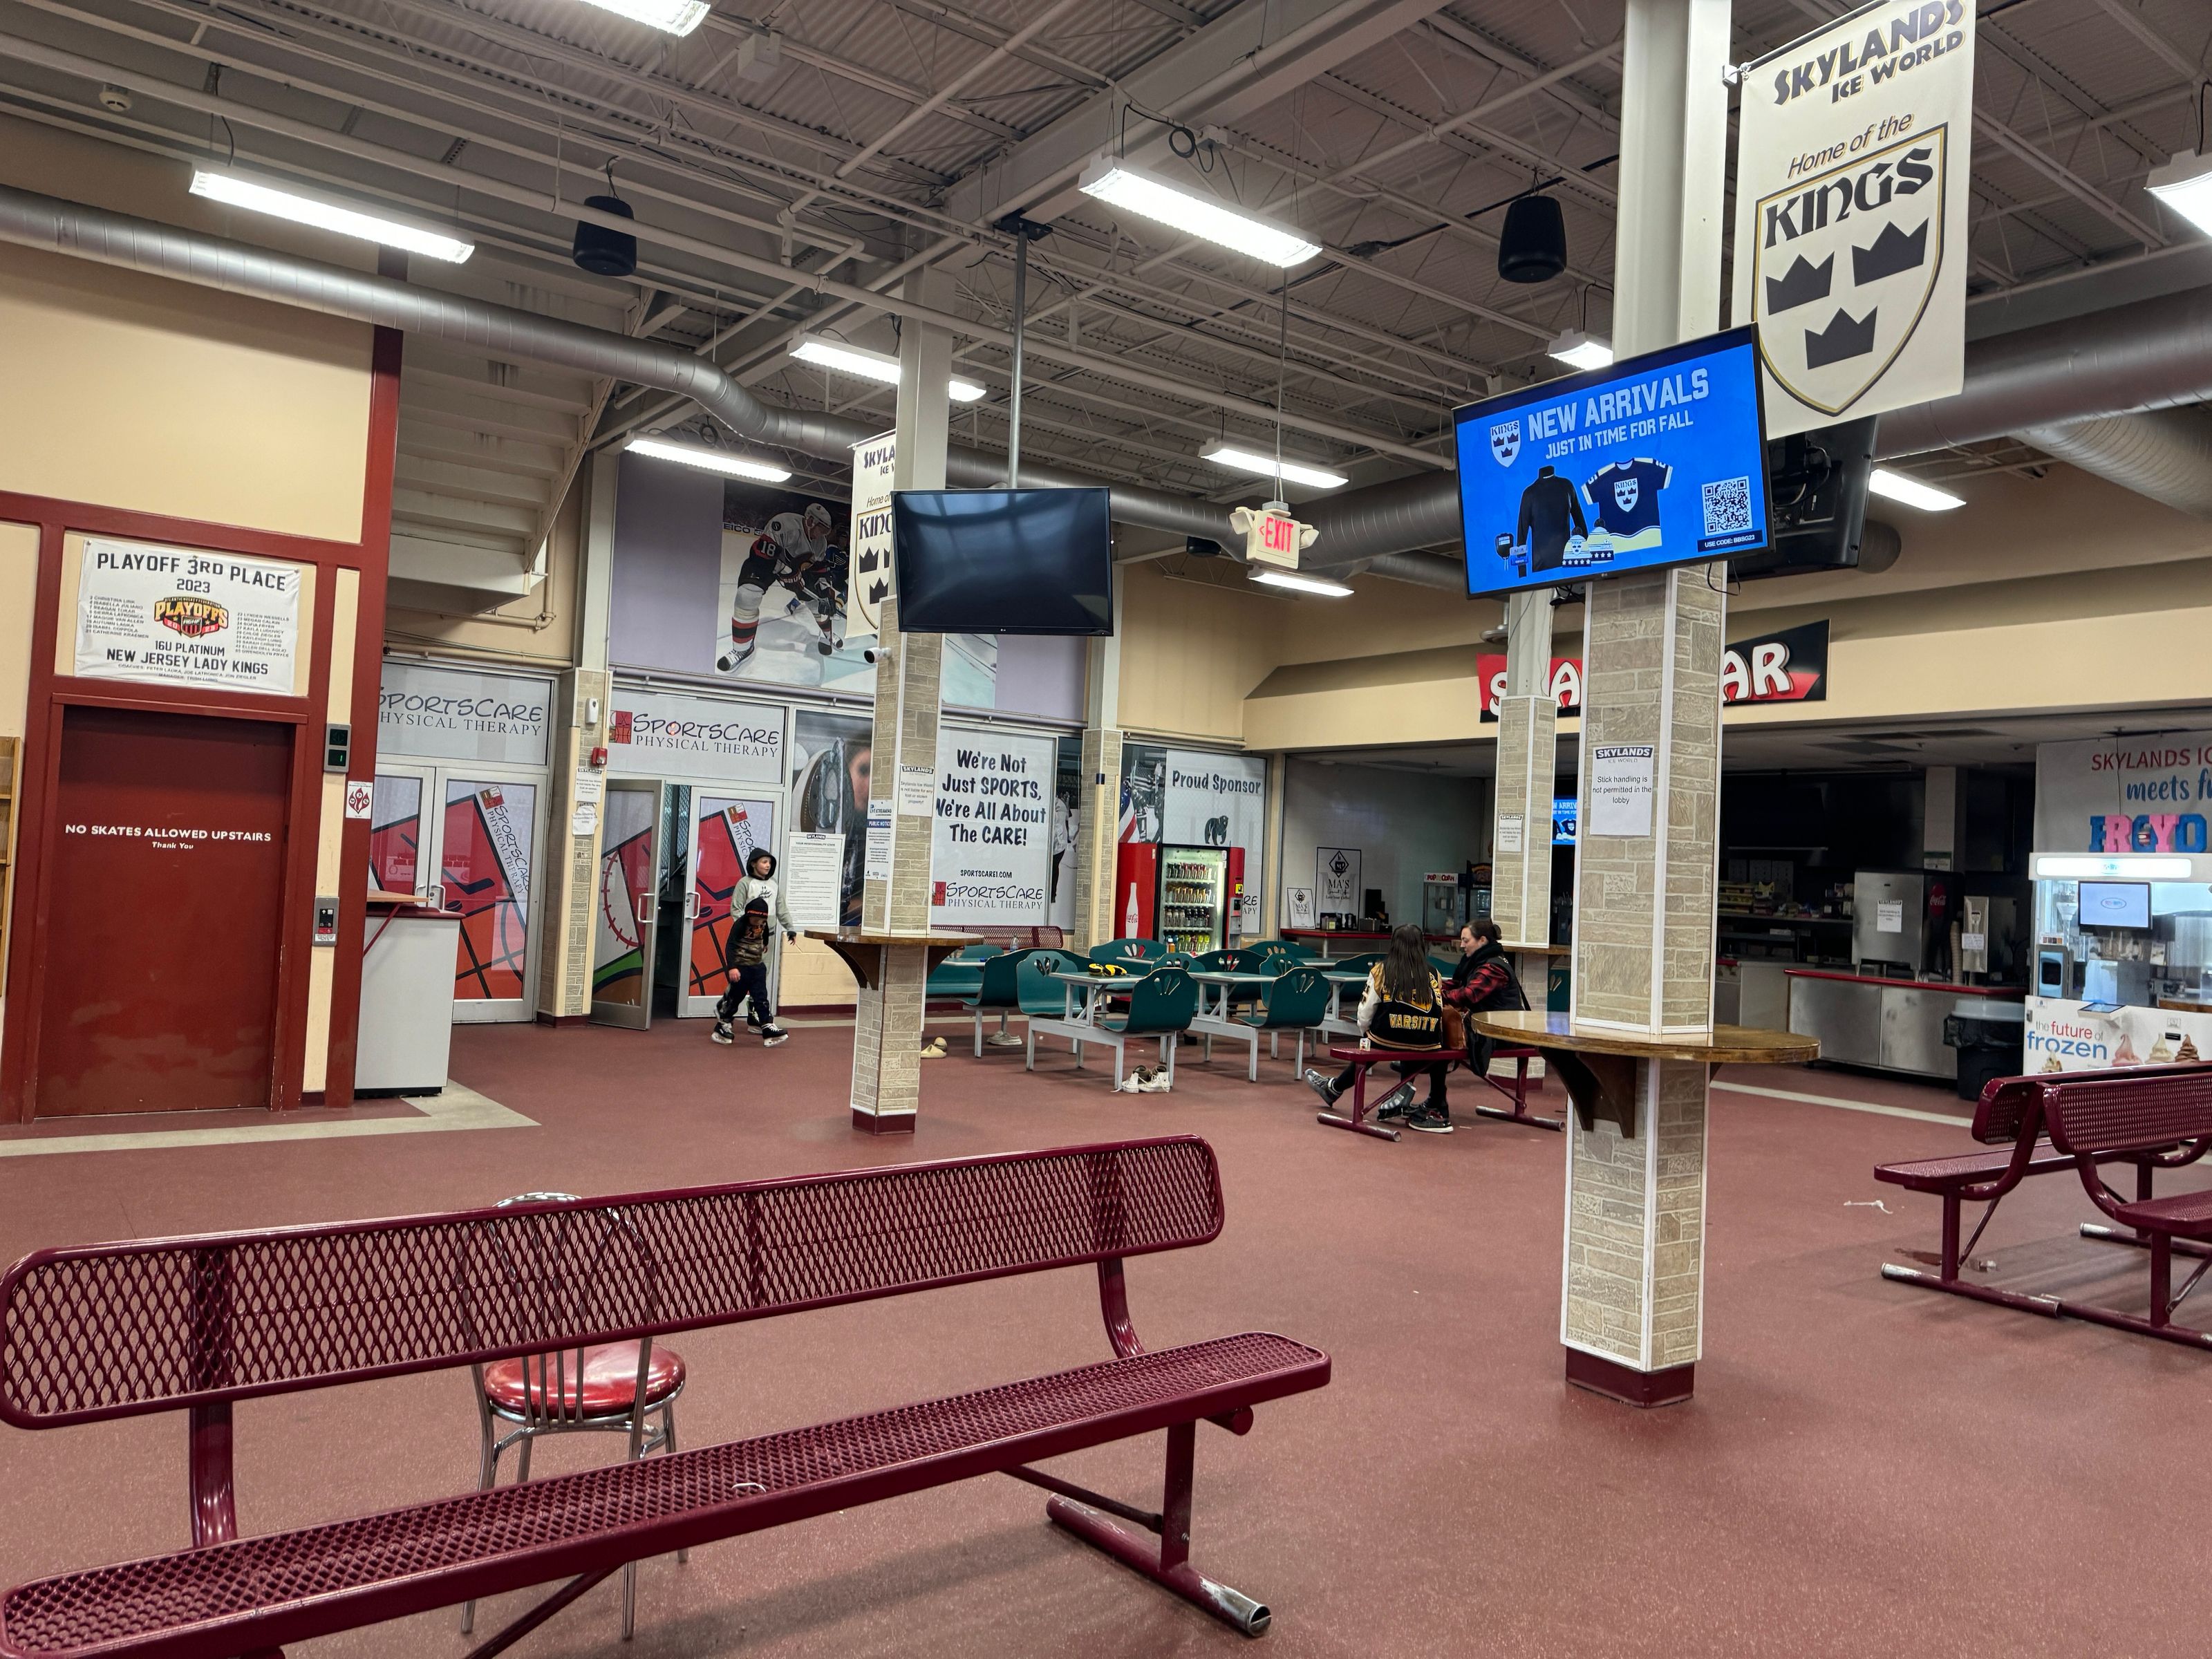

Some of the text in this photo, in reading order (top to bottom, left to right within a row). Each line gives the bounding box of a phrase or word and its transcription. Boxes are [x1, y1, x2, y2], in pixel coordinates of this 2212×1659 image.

[1774, 0, 1964, 106] SKYLANDS
[1831, 30, 1966, 104] ICE WORLD
[1787, 113, 1914, 179] Home of the
[1765, 148, 1933, 250] KINGS
[1527, 367, 1709, 442] NEW ARRIVALS
[1490, 421, 1520, 437] KINGS
[1545, 410, 1694, 460] JUST IN TIME FOR FALL
[864, 444, 896, 469] SKYLA
[880, 466, 889, 476] ICE
[867, 496, 883, 508] Home
[1265, 516, 1294, 553] EXIT
[761, 541, 776, 556] 18
[97, 552, 285, 592] PLAYOFF 3RD PLACE
[176, 579, 210, 593] 2023
[155, 600, 228, 629] PLAYOFFS
[155, 640, 172, 651] 16U
[175, 642, 225, 657] PLATINUM
[106, 648, 269, 675] NEW JERSEY LADY KINGS
[1723, 642, 1795, 702] AR
[381, 711, 541, 736] HYSICAL THERAPY
[633, 713, 780, 745] SPORTSCARE
[636, 735, 778, 758] PHYSICAL THERAPY
[1597, 748, 1650, 758] SKYLANDS
[903, 766, 933, 774] SKYLANDS
[957, 749, 1027, 774] We're Not
[2091, 748, 2191, 771] SKYLANDS
[942, 774, 1042, 800] Just SPORTS,
[1172, 770, 1261, 794] Proud Sponsor
[1613, 776, 1640, 784] handling
[2126, 775, 2190, 802] meets
[974, 801, 996, 820] All
[1000, 804, 1047, 823] About
[65, 824, 271, 841] NO SKATES ALLOWED UPSTAIRS
[949, 823, 1027, 846] The CARE!
[2089, 813, 2207, 853] FROYO
[487, 811, 526, 894] PHYSICAL THERAPY
[946, 883, 1044, 900] SPORTSCARE
[1328, 879, 1350, 889] MA'S
[948, 899, 1043, 910] PHYSICAL THERAPY
[1389, 1013, 1438, 1031] VARSITY
[2036, 1020, 2103, 1041] the future of
[2026, 1031, 2108, 1060] frozen
